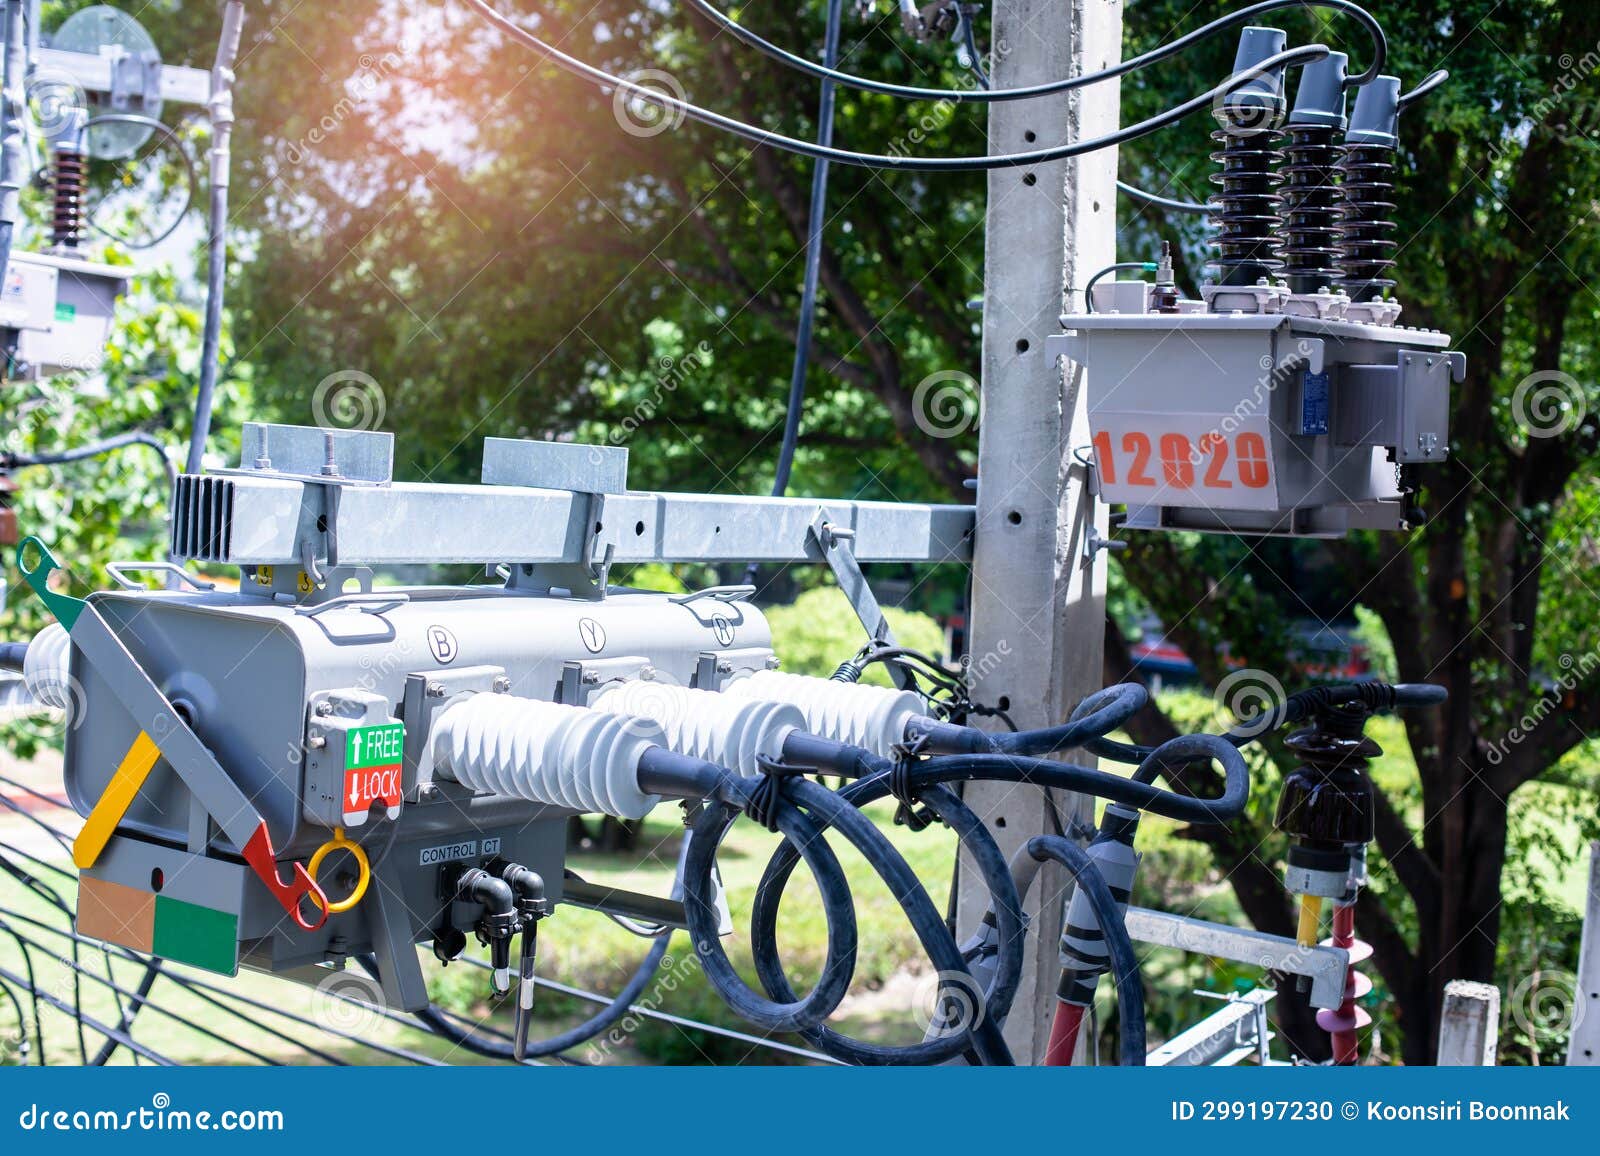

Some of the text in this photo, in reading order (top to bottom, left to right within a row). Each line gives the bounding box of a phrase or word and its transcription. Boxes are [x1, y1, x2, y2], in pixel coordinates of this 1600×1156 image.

[1093, 431, 1270, 490] 12020
[582, 622, 599, 648] Y
[716, 618, 730, 641] R
[435, 630, 451, 657] B
[366, 728, 401, 760] FREE
[363, 769, 398, 800] LOCK
[422, 843, 475, 863] CONTROL
[484, 839, 499, 853] CT
